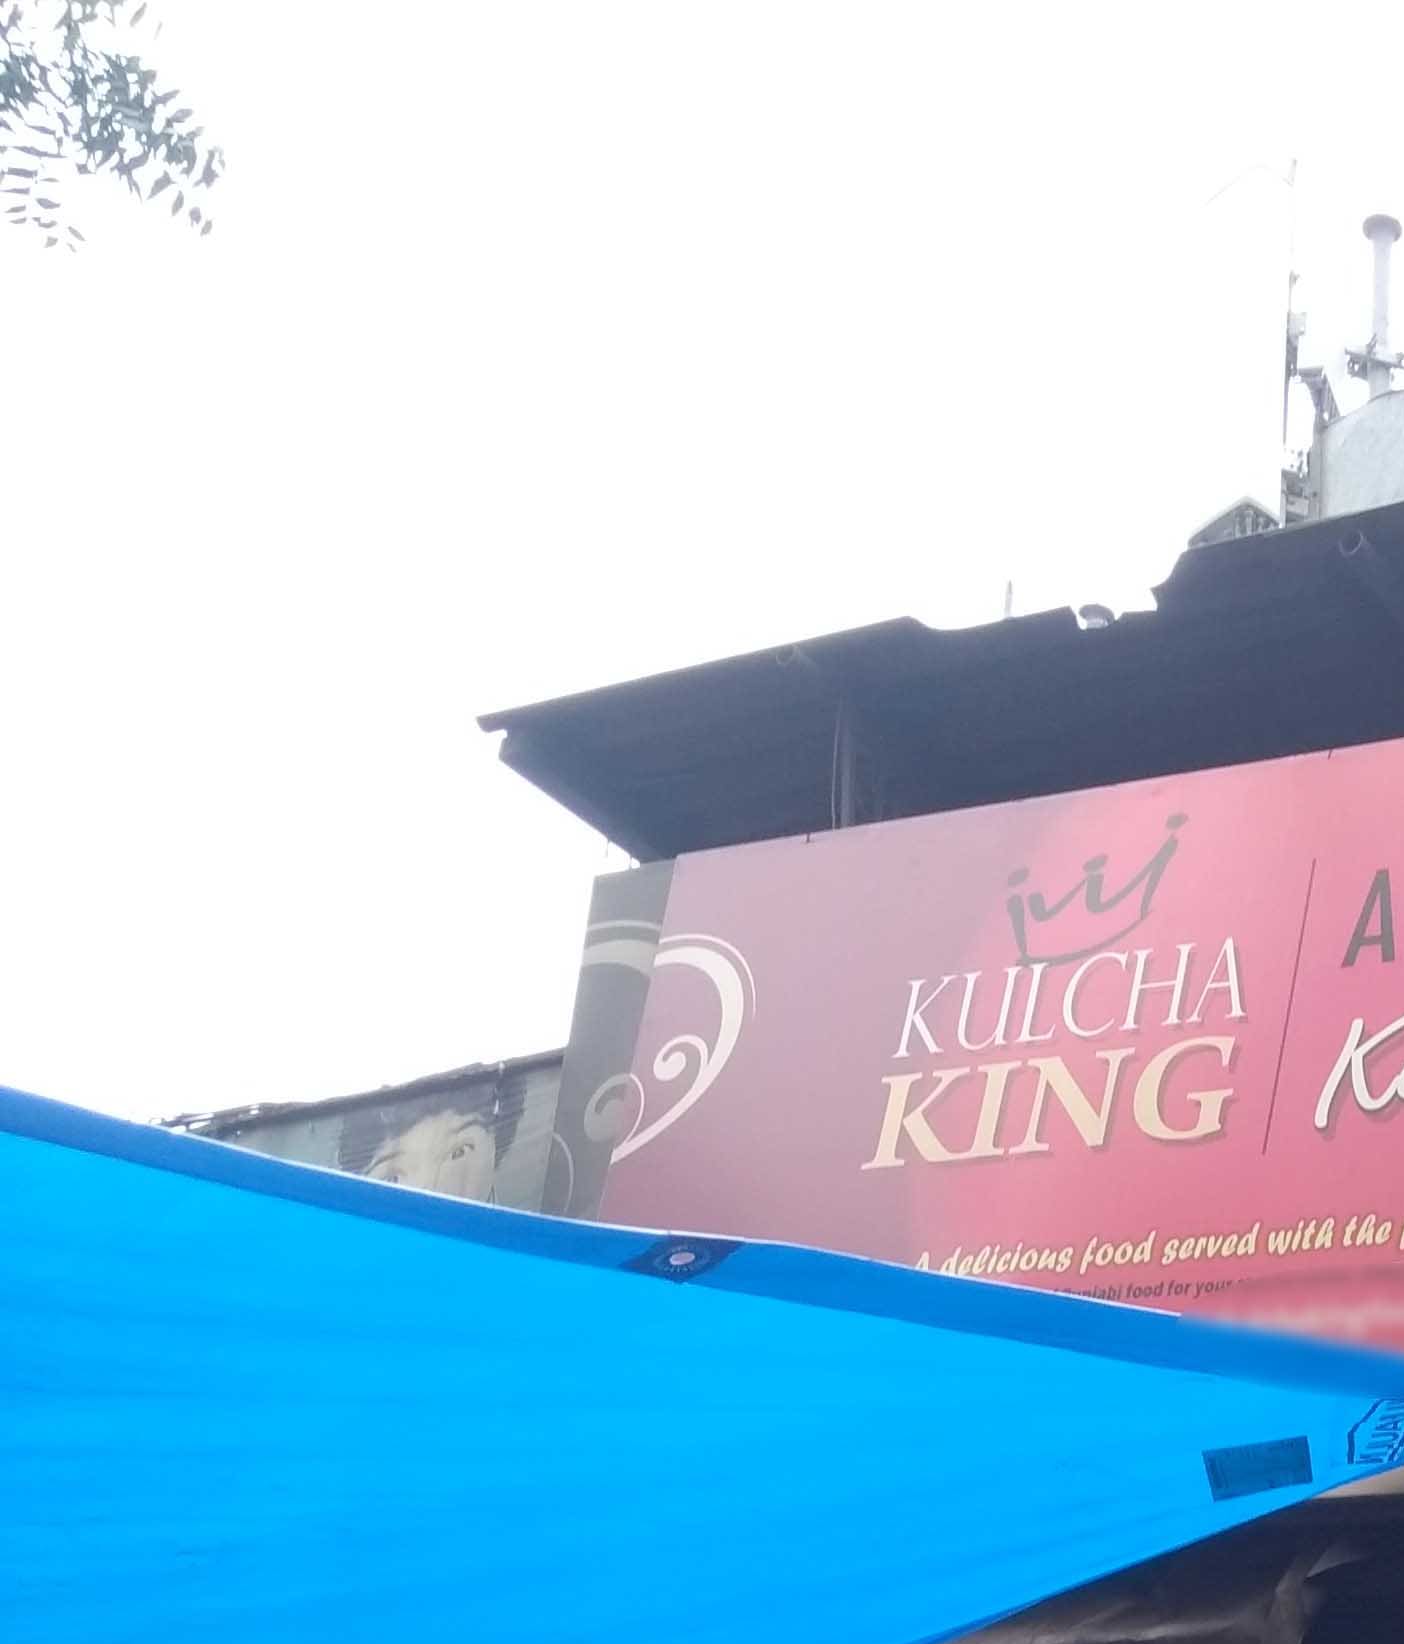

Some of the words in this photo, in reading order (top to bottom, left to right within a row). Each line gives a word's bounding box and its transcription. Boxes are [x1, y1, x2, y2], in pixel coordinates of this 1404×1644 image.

[892, 936, 1244, 1058] KULCHA
[861, 1036, 1235, 1170] KING
[939, 1241, 1074, 1276] delicious
[1080, 1231, 1157, 1275] food
[1161, 1222, 1261, 1266] served
[1267, 1218, 1335, 1256] with
[1342, 1214, 1392, 1247] the
[1126, 1282, 1164, 1299] food
[1167, 1278, 1191, 1299] for
